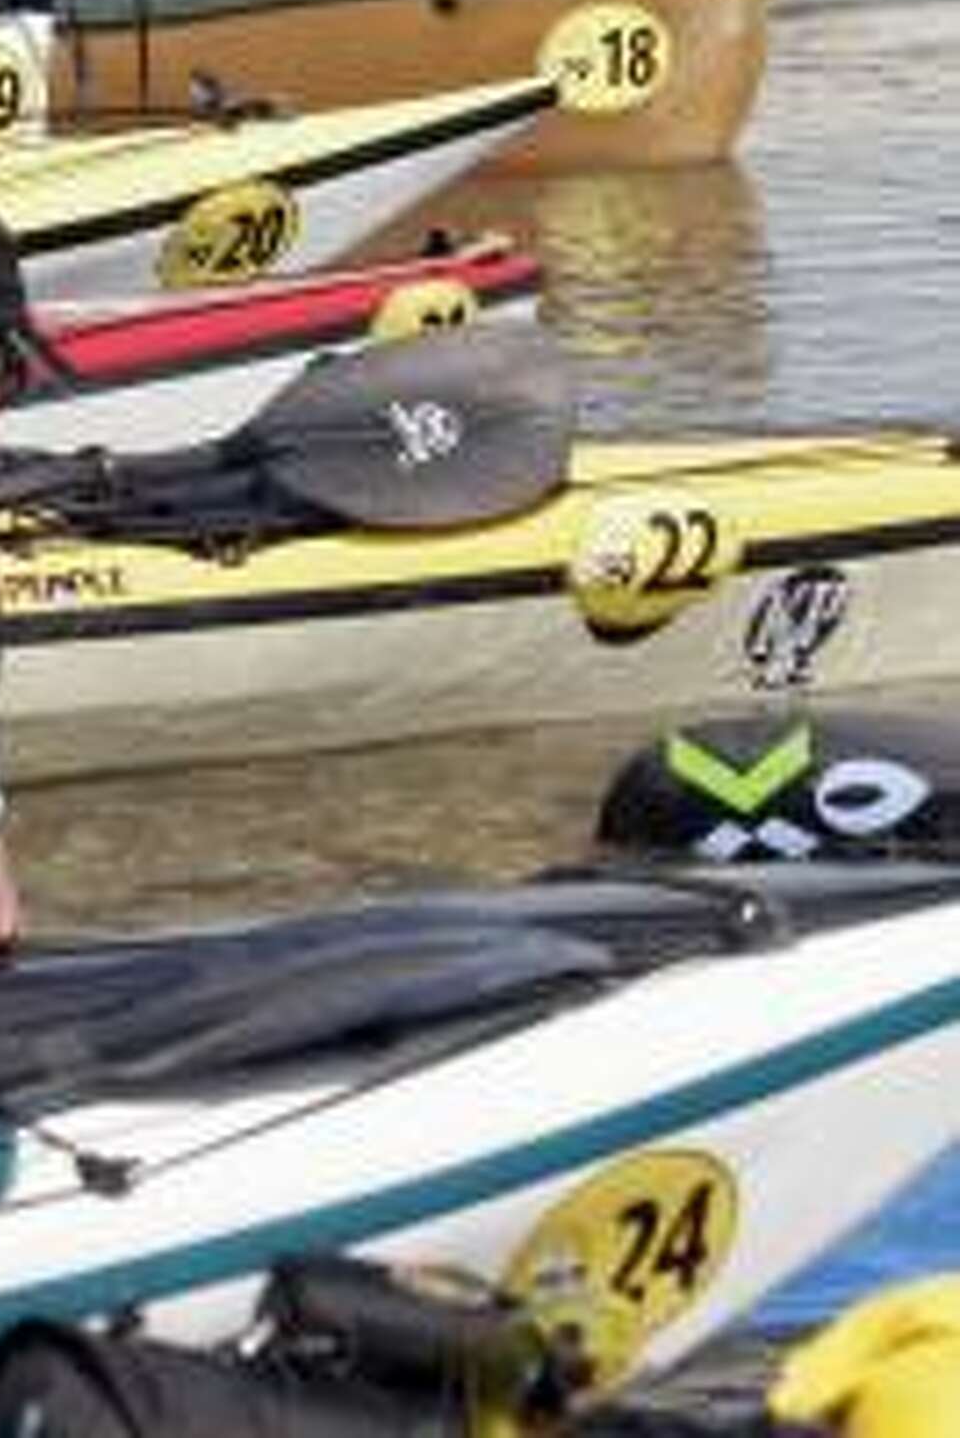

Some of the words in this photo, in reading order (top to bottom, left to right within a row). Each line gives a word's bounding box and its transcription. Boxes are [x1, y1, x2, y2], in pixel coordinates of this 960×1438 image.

[599, 27, 659, 87] 18
[214, 207, 285, 273] 20
[642, 509, 716, 591] 22
[612, 1182, 714, 1302] 24
